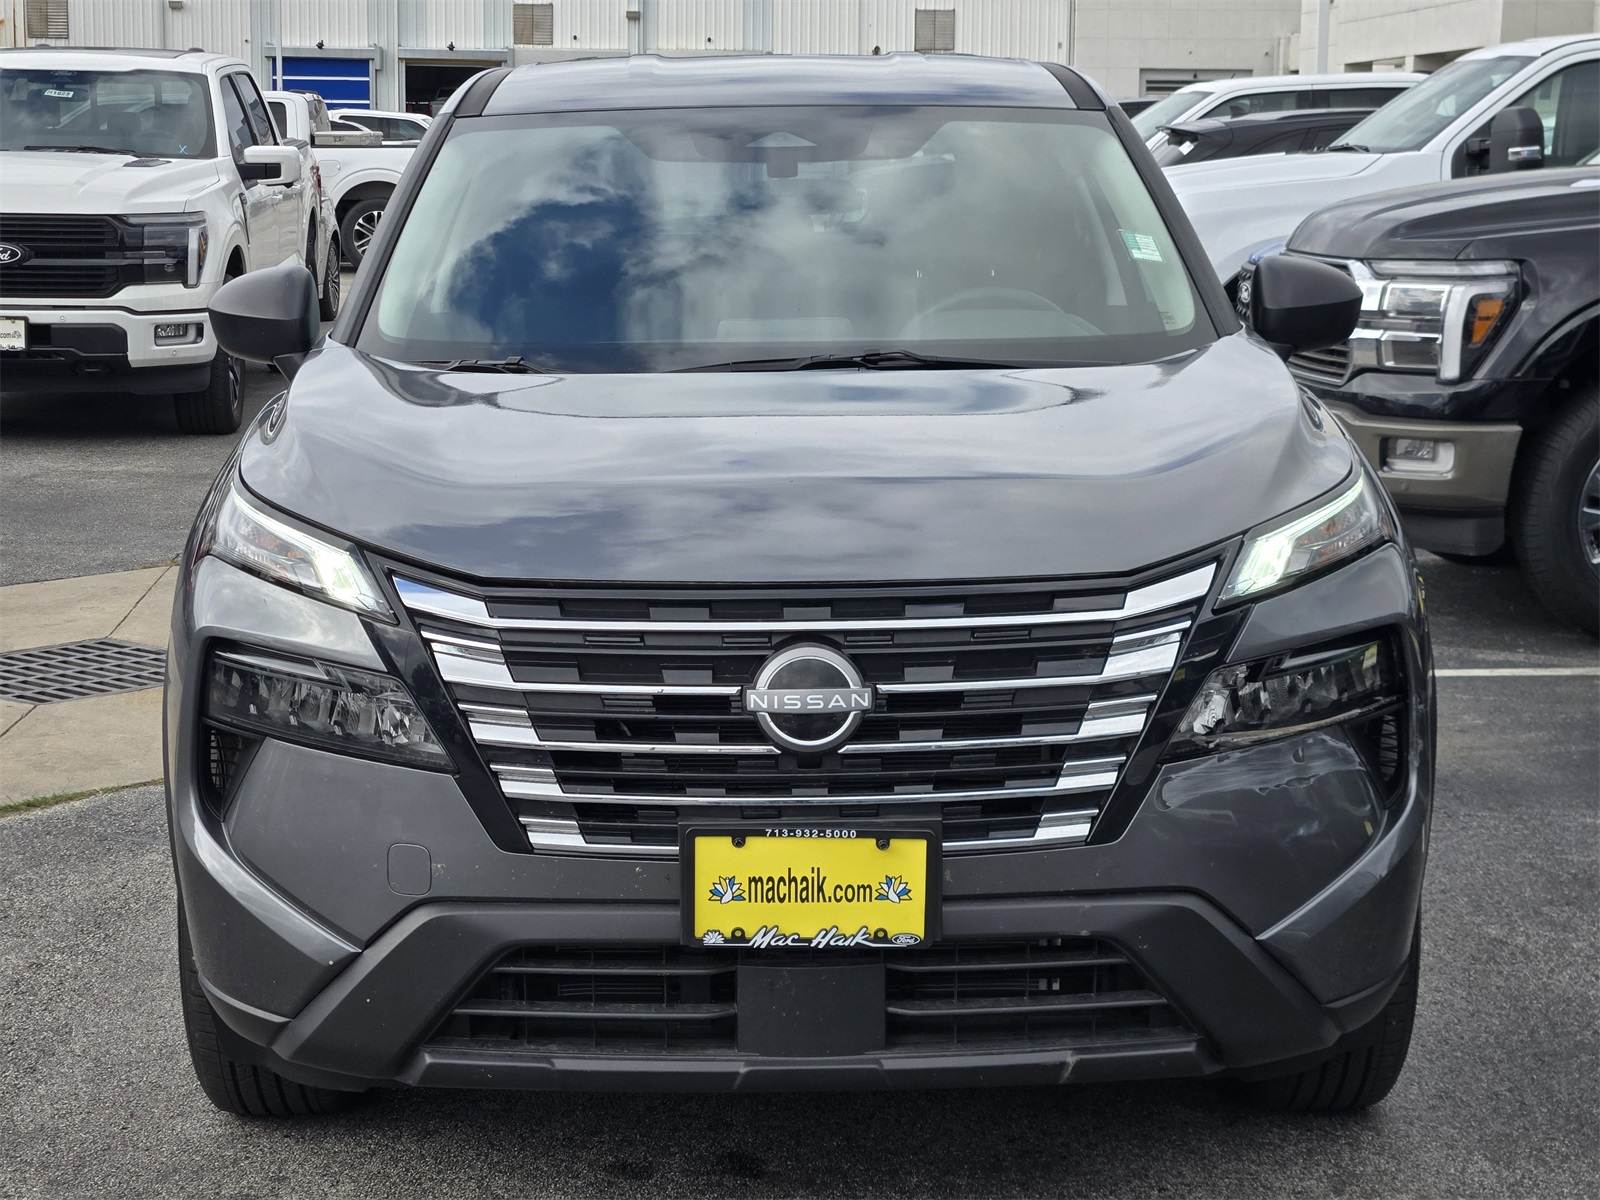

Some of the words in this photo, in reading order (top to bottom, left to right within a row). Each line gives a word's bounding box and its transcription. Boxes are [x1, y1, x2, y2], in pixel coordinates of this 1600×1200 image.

[750, 693, 869, 709] NISSAN
[765, 828, 857, 839] 713-932-5000
[748, 867, 873, 904] machaik.com
[748, 925, 803, 948] Mac
[810, 925, 873, 948] Haik
